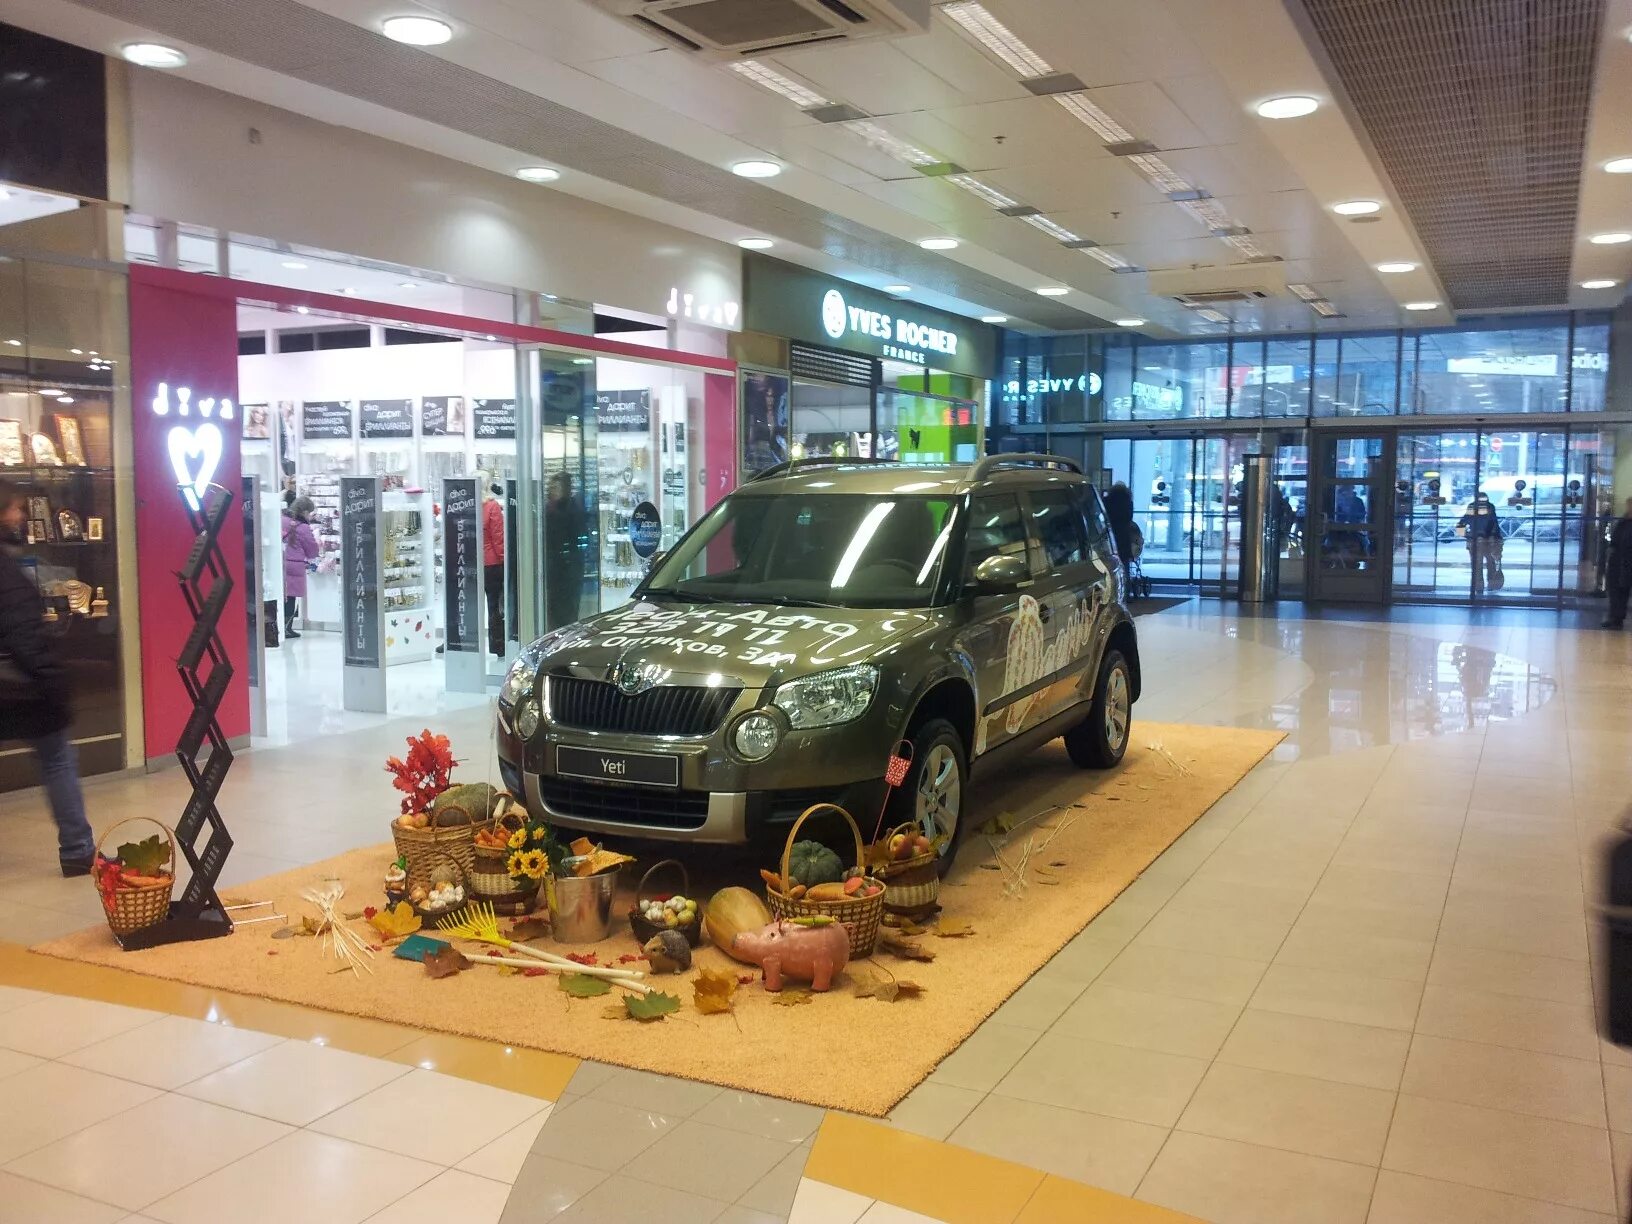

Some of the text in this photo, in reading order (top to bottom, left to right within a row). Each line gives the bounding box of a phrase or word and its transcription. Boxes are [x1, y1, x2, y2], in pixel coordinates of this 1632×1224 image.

[847, 305, 958, 355] YVES ROCHER
[882, 344, 926, 364] FRANCE
[152, 382, 234, 420] diva
[600, 758, 626, 775] Yeti
